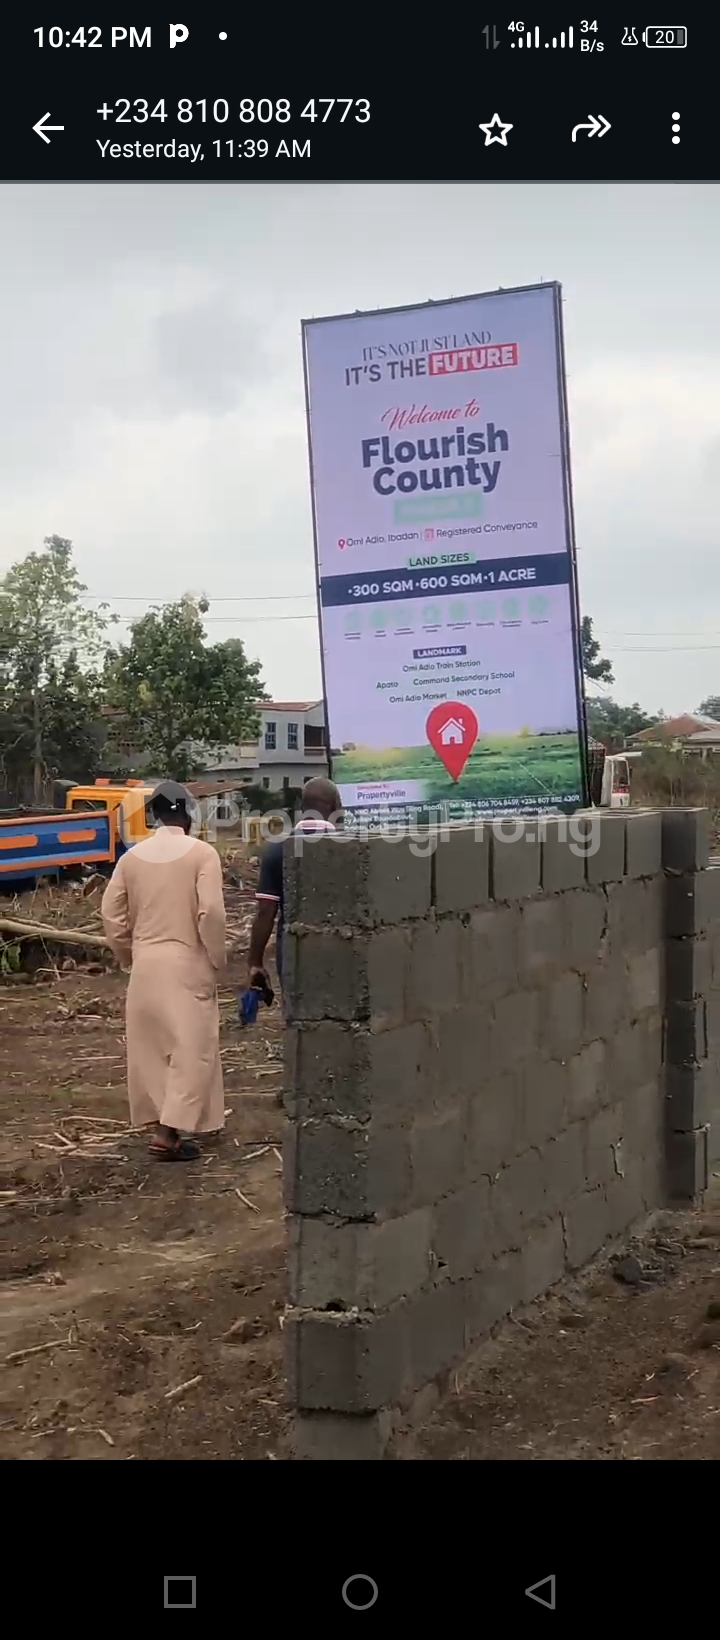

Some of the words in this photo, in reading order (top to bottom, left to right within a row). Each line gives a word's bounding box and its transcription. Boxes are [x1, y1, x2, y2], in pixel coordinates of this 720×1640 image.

[507, 22, 525, 32] 4G
[579, 21, 599, 32] 34
[33, 27, 103, 49] 10:42
[110, 27, 152, 49] PM
[655, 30, 674, 44] 20
[579, 39, 605, 54] B/s
[96, 99, 168, 124] +234
[177, 99, 229, 124] 810
[238, 99, 291, 124] 808
[299, 99, 372, 124] 4773
[96, 138, 205, 163] Yesterday,
[211, 139, 269, 158] 11:39
[274, 139, 312, 158] AM
[390, 342, 417, 357] NOT
[420, 336, 452, 353] JUST
[452, 331, 492, 348] LAND
[345, 364, 382, 387] IT'S
[387, 358, 427, 379] THE
[431, 346, 515, 374] FUTURE
[380, 403, 462, 432] Welcome
[463, 398, 480, 418] to
[361, 422, 509, 468] Flourish
[373, 457, 501, 496] County
[346, 537, 364, 548] Omi
[387, 531, 419, 543] Ibadan
[436, 525, 482, 539] Registered
[483, 520, 538, 534] Conveyance
[409, 555, 438, 567] LAND
[440, 553, 470, 565] SIZES
[498, 568, 536, 582] ACRE
[416, 647, 463, 658] LANDMARK
[436, 661, 454, 670] Train
[455, 659, 481, 668] Station
[413, 676, 450, 686] Command
[451, 673, 489, 684] Secondary
[490, 671, 515, 680] School
[422, 692, 447, 701] Market
[456, 689, 477, 698] NNPC
[478, 687, 501, 697] Depot
[356, 789, 406, 801] Propertyville
